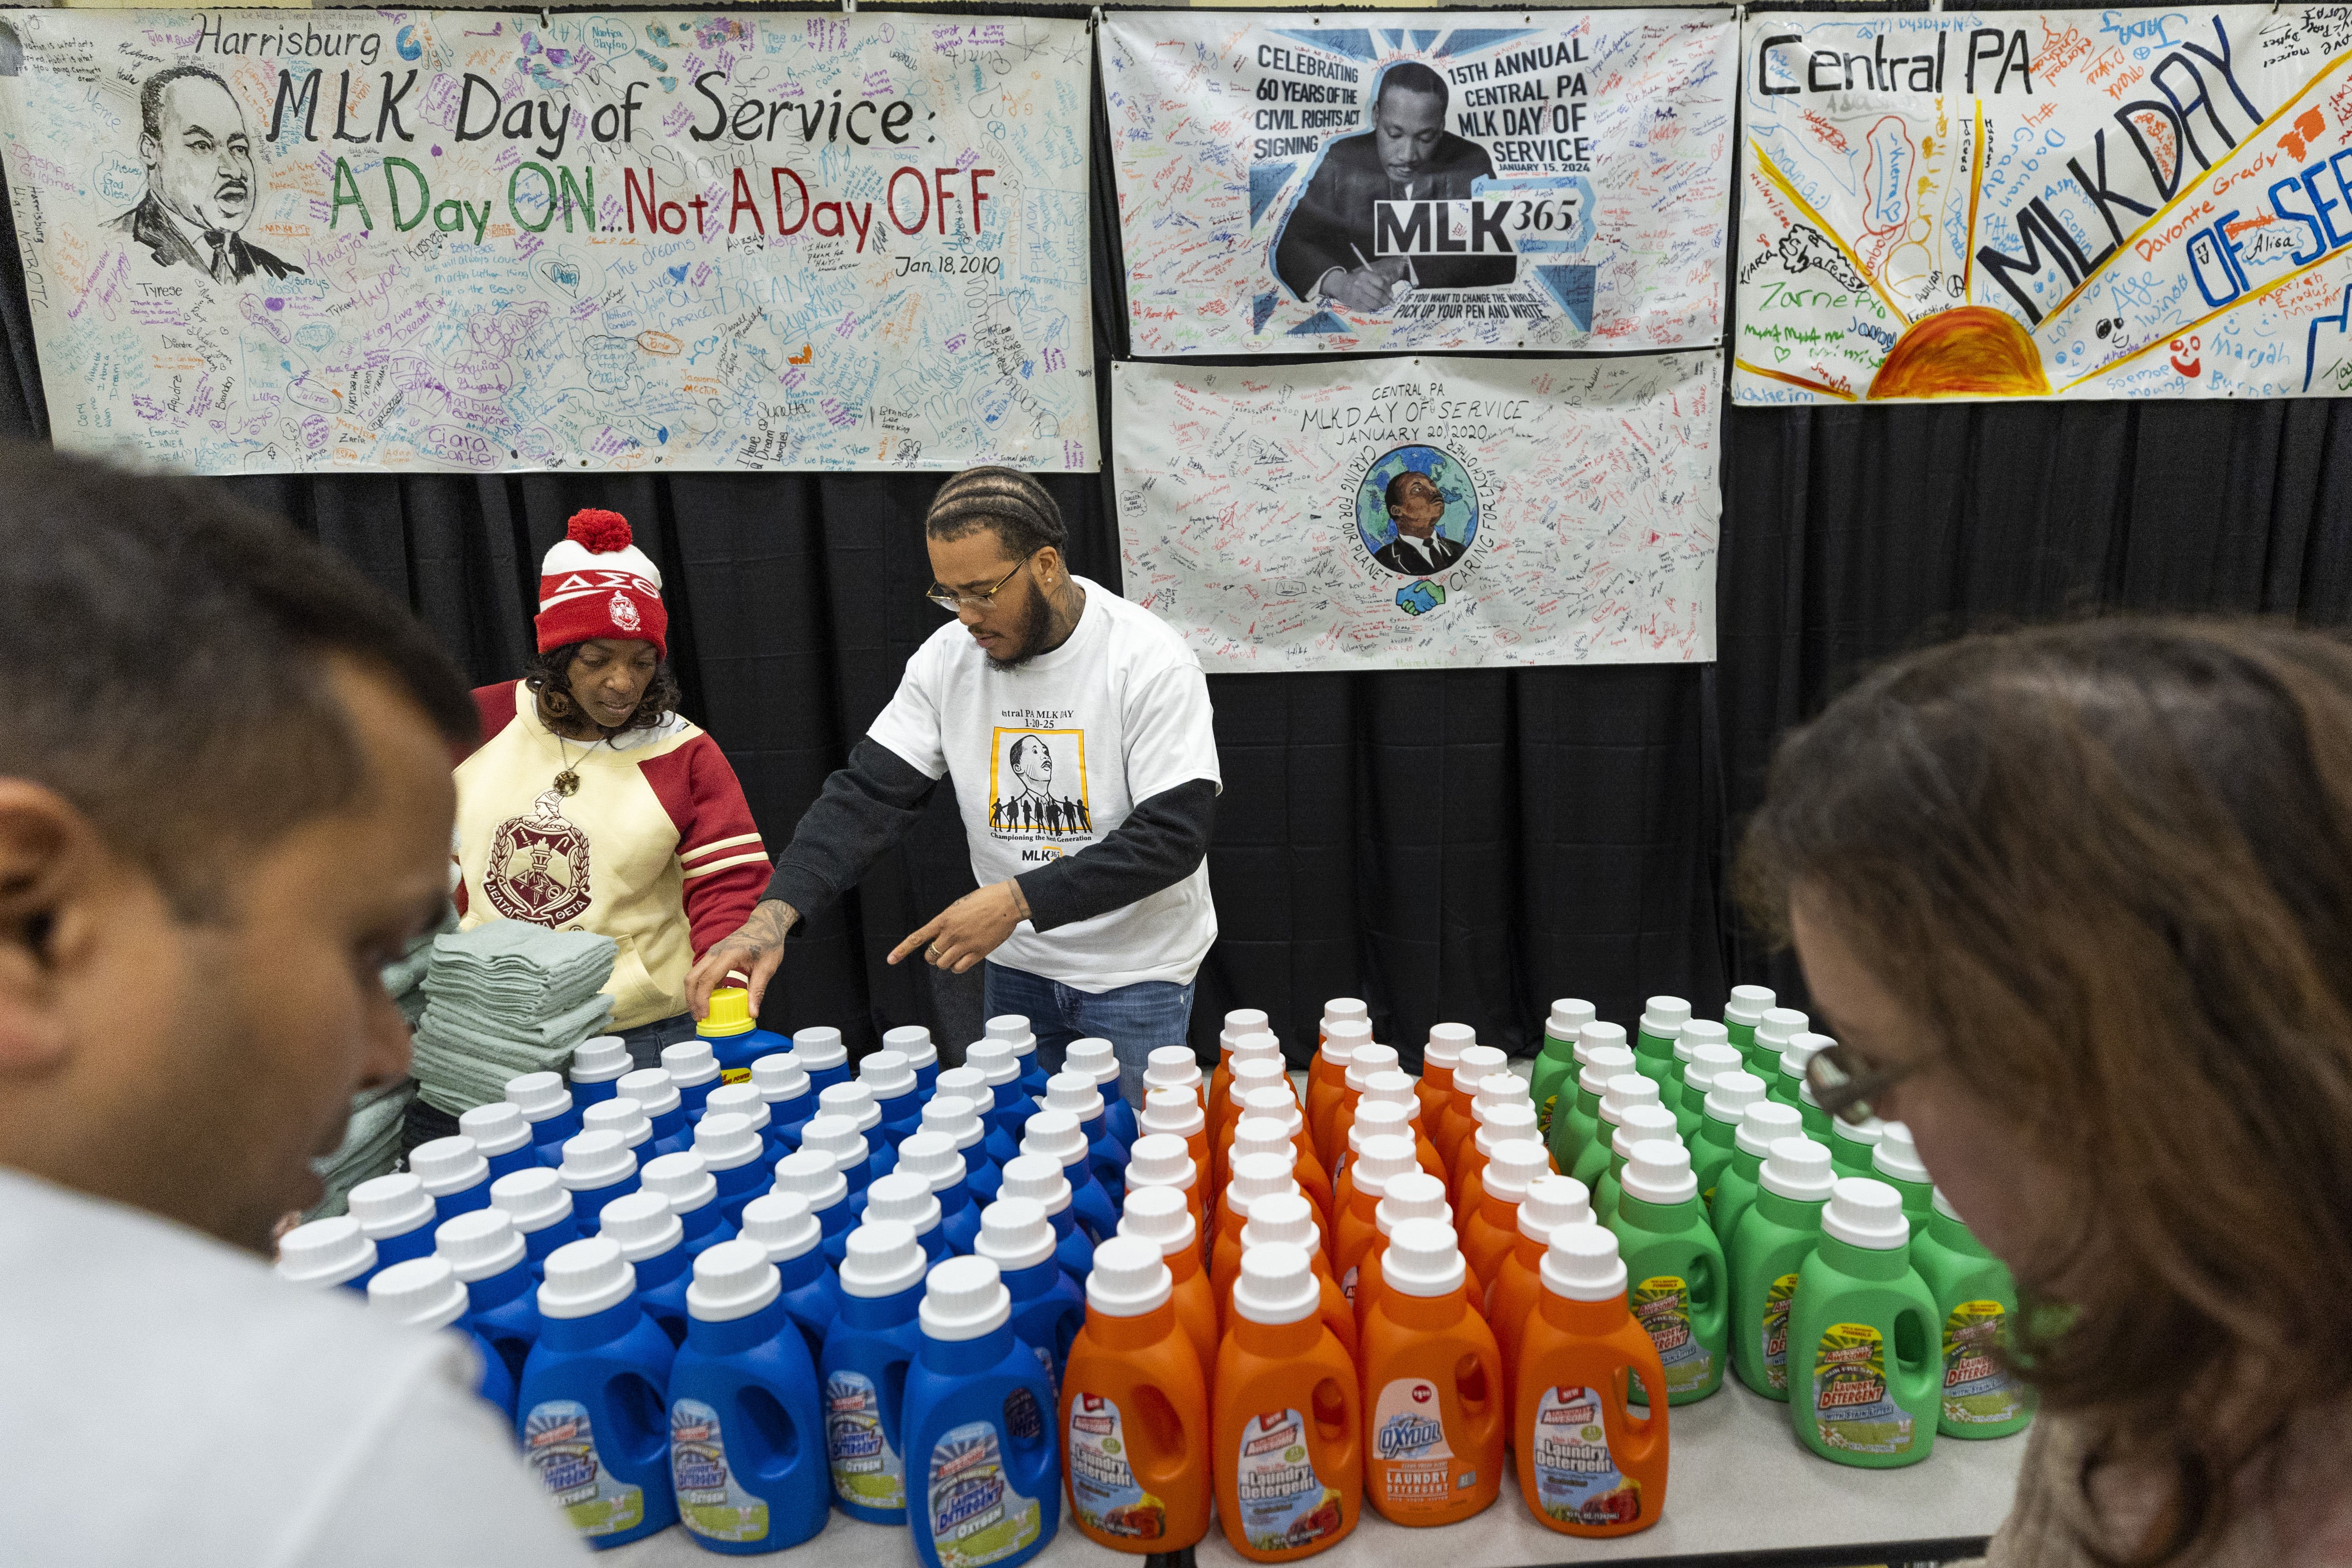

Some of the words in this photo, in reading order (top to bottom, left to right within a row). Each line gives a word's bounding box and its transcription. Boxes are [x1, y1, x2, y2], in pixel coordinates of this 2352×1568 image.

[192, 13, 380, 64] Harrisburg
[1257, 45, 1358, 83] CELEBRATING
[1448, 63, 1489, 86] 15TH
[1494, 38, 1589, 78] ANNUAL
[1759, 31, 1946, 95] Central
[1965, 28, 2033, 94] PA
[1256, 78, 1277, 101] 60
[1281, 81, 1324, 104] YEARS
[1326, 86, 1340, 104] OF
[1341, 87, 1357, 104] THE
[1465, 79, 1549, 108] CENTRAL
[1557, 72, 1588, 98] PA
[267, 69, 417, 143] MLK
[456, 72, 570, 161] Day
[592, 82, 649, 142] of
[689, 71, 935, 146] Service:
[1255, 109, 1298, 131] CIVIL
[1302, 109, 1342, 129] RIGHTS
[1344, 110, 1360, 125] ACT
[1458, 110, 1499, 137] MLK
[1505, 104, 1547, 136] DAY
[1552, 103, 1587, 134] OF
[1254, 136, 1319, 160] SIGNING
[1493, 137, 1591, 163] SERVICE
[1562, 163, 1590, 172] 2024
[1976, 128, 2157, 326] MLK
[2114, 15, 2264, 202] DAY
[330, 157, 374, 232] A
[384, 156, 491, 245] Day
[624, 167, 707, 234] Not
[729, 167, 765, 234] A
[772, 167, 872, 254] Day
[887, 166, 996, 236] OFF
[1380, 201, 1517, 253] MLK
[1513, 200, 1578, 232] 365
[2186, 210, 2250, 308] OF
[2246, 234, 2295, 260] Alisa
[895, 256, 933, 277] Jan.
[939, 257, 956, 276] 18,
[960, 256, 1000, 274] 2010
[136, 283, 182, 297] Tyrese
[1404, 293, 1413, 302] IF
[1415, 293, 1428, 302] YOU
[1430, 293, 1451, 302] WANT
[1452, 293, 1460, 302] TO
[1462, 293, 1491, 302] CHANGE
[1492, 293, 1507, 302] THE
[1393, 304, 1419, 318] PICK
[1420, 305, 1435, 318] UP
[1437, 305, 1464, 318] YOUR
[1466, 305, 1485, 318] PEN
[1488, 305, 1510, 318] AND
[983, 337, 1000, 348] LOVE
[1372, 384, 1421, 400] CENTRAL
[1431, 383, 1444, 395] PA
[1301, 407, 1342, 431] MLK
[1347, 402, 1397, 427] DAY
[1406, 402, 1428, 421] OF
[1438, 401, 1529, 420] SERVICE
[1336, 427, 1418, 445] JANUARY
[1453, 425, 1488, 439] 2020
[1447, 439, 1478, 467] OTHER
[1341, 446, 1376, 492] CARING
[1473, 467, 1495, 497] EACH
[1339, 496, 1353, 519] FOR
[1483, 503, 1497, 530] FOR
[1343, 522, 1358, 541] OUR
[1351, 544, 1393, 585] PLANET
[1450, 535, 1494, 591] CARING
[1025, 719, 1054, 728] 1-20-25
[1036, 711, 1058, 719] MLK
[991, 832, 1033, 842] Championing
[1022, 850, 1050, 862] MLK
[1820, 1386, 1884, 1408] DETERGENT
[1535, 1449, 1612, 1474] Detergent
[1545, 1439, 1607, 1460] Laundry
[1386, 1471, 1449, 1484] LAUNDRY
[1387, 1484, 1449, 1494] DETERGENT
